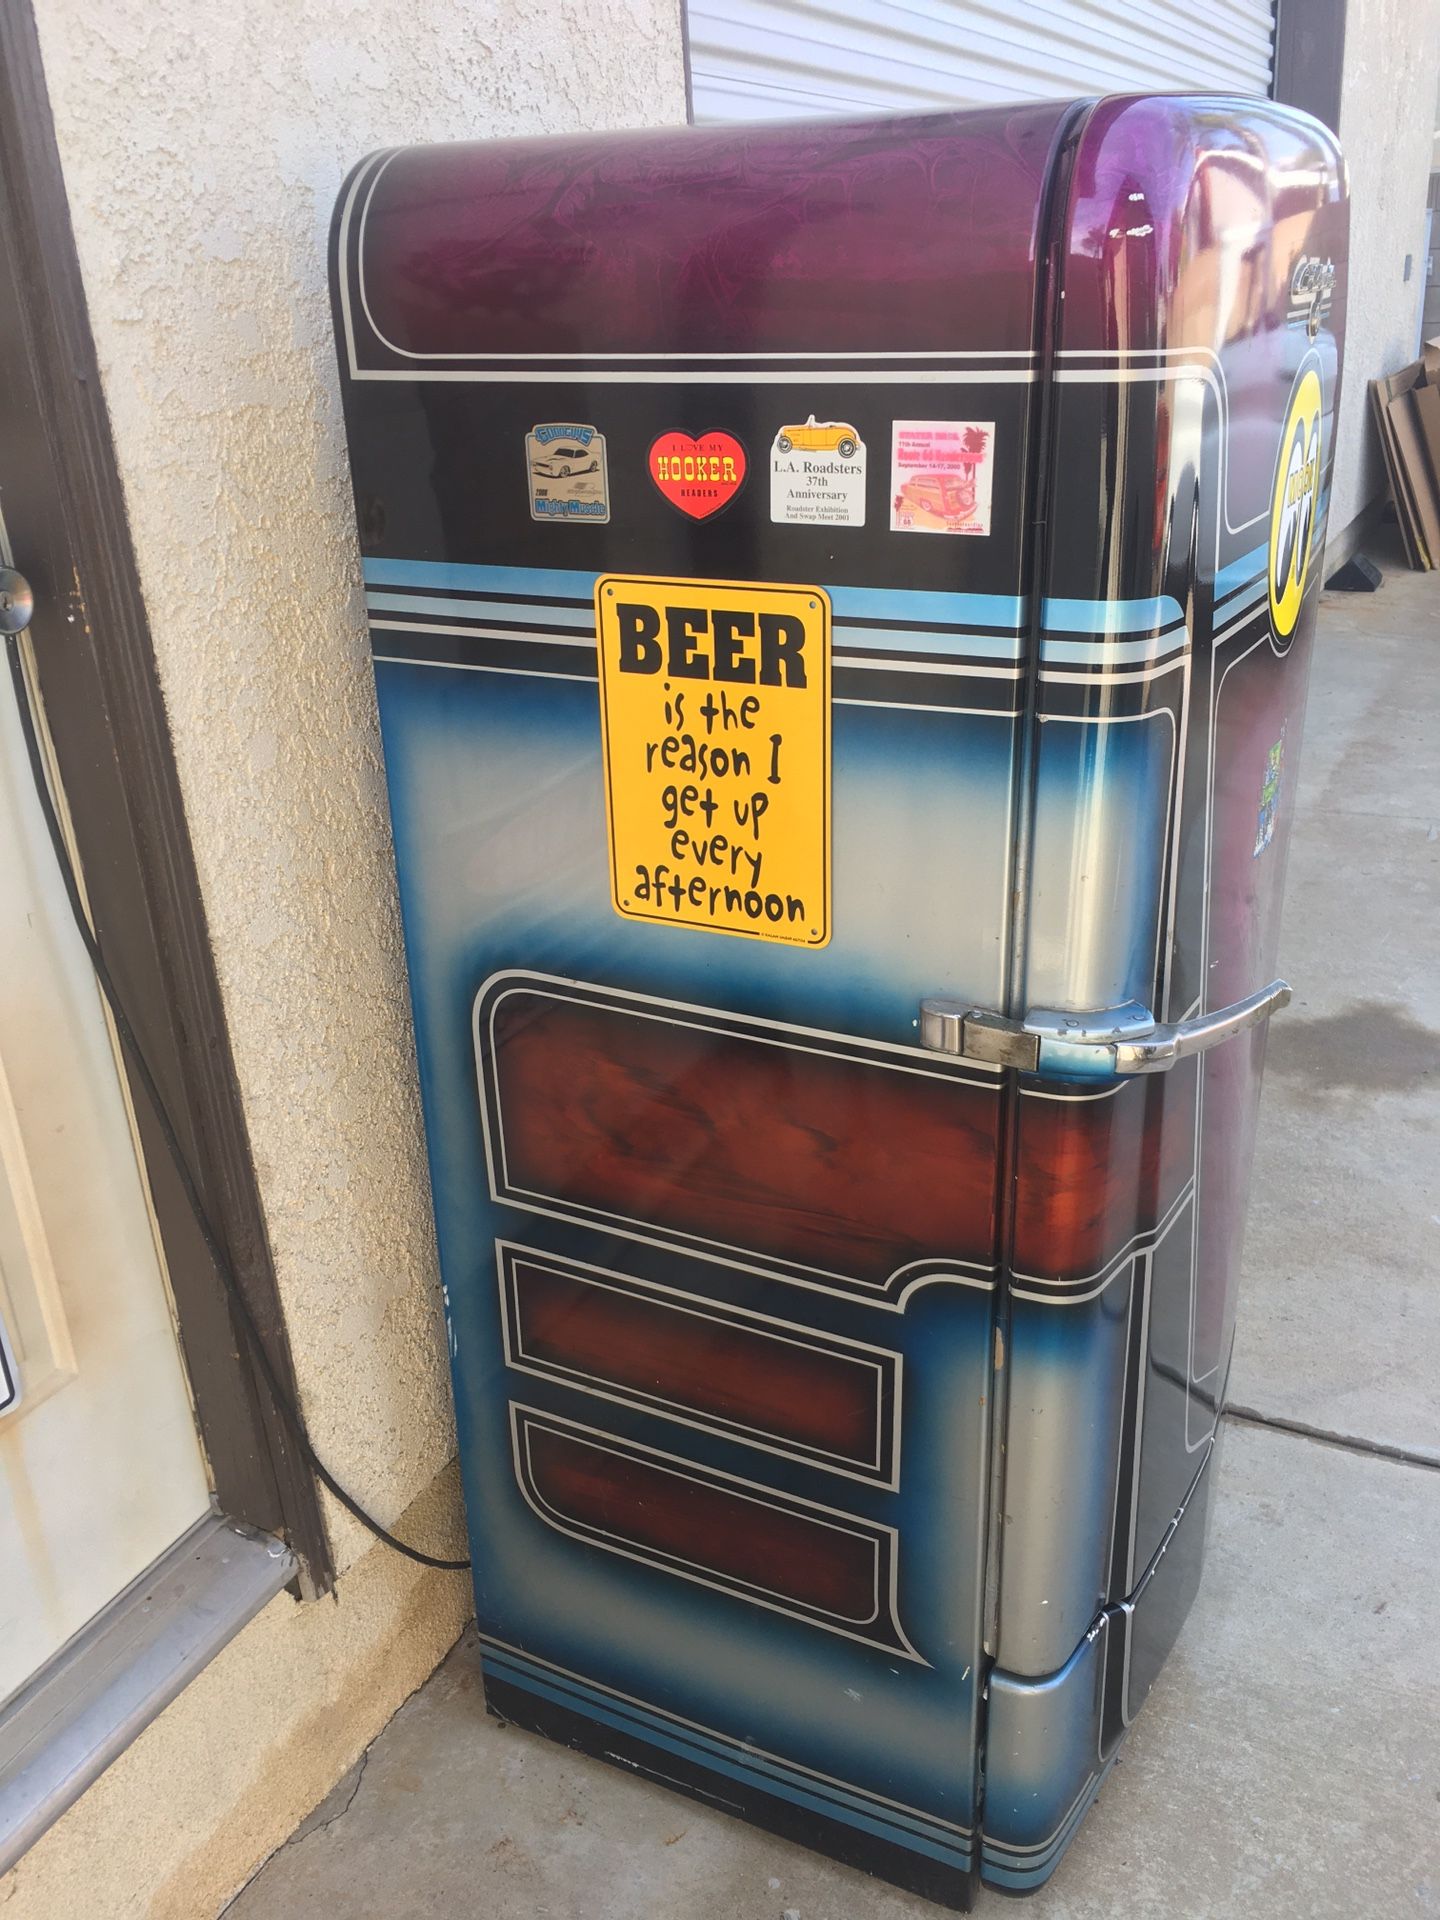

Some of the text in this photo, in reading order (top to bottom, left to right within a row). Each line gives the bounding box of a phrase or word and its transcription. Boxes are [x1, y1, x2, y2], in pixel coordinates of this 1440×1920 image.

[709, 444, 723, 452] MY
[657, 455, 738, 482] HOOKER
[774, 460, 863, 475] L.A. Roadsters
[806, 476, 829, 487] 37th
[681, 488, 718, 498] HEADERS
[786, 489, 849, 503] Anniversary
[535, 498, 608, 516] Mighty Muscle
[786, 505, 849, 514] Roadster Exhibition
[800, 513, 817, 521] Swap
[616, 603, 807, 689] BEER
[663, 683, 760, 735] is the
[646, 733, 783, 785] reason I
[662, 785, 769, 840] get up
[671, 829, 762, 889] every
[634, 864, 805, 922] afternoon
